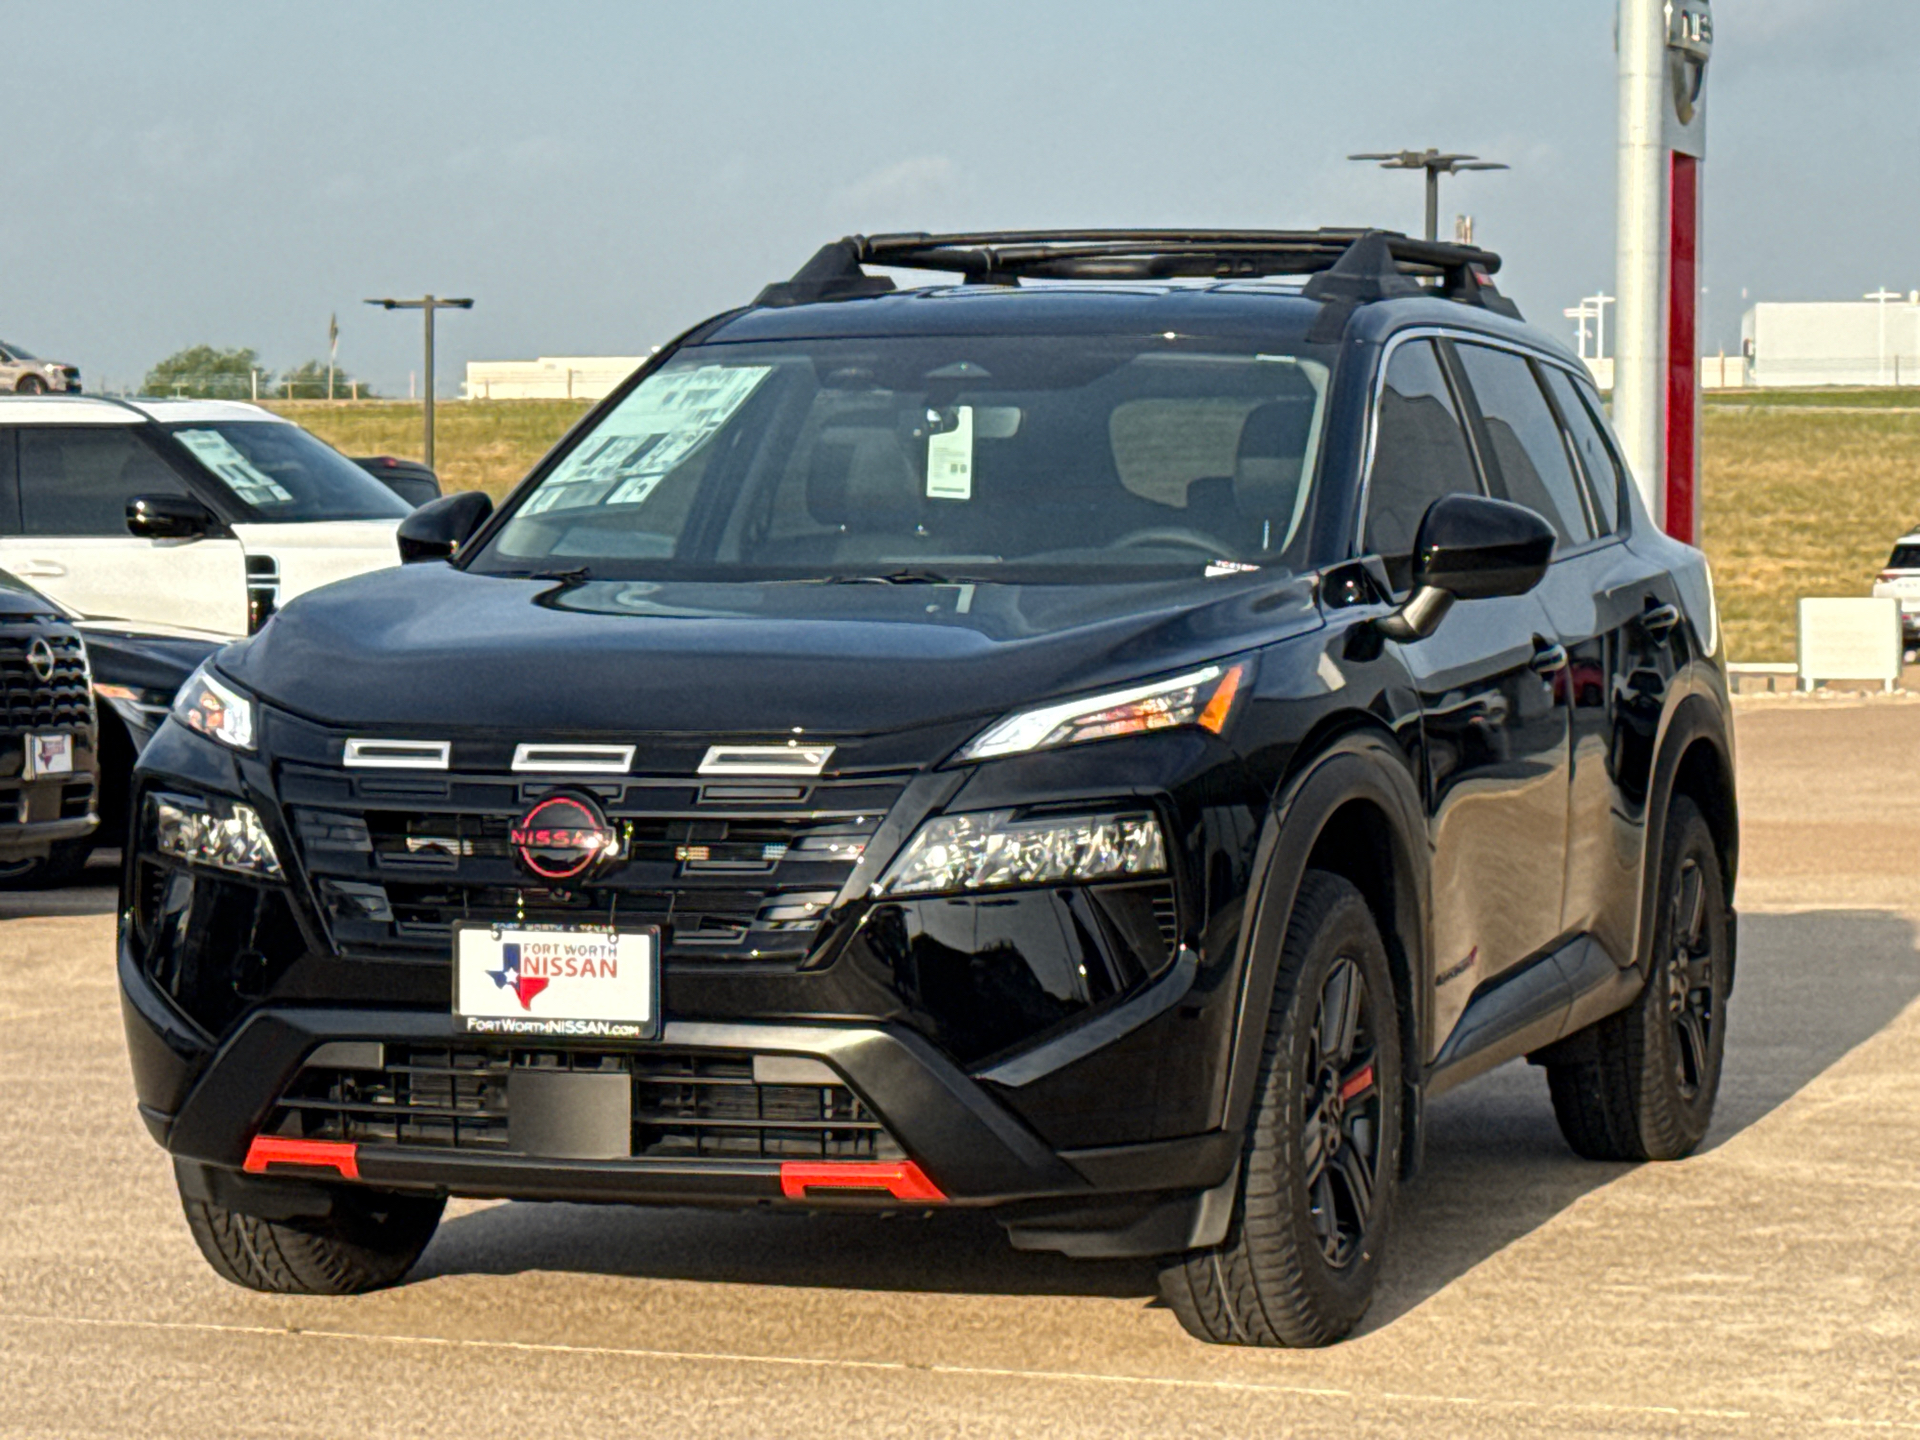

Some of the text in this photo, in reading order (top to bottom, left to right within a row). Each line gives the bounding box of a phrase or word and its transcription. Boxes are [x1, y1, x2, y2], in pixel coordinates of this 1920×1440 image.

[523, 943, 617, 957] FORT WORTH
[523, 956, 617, 978] NISSAN
